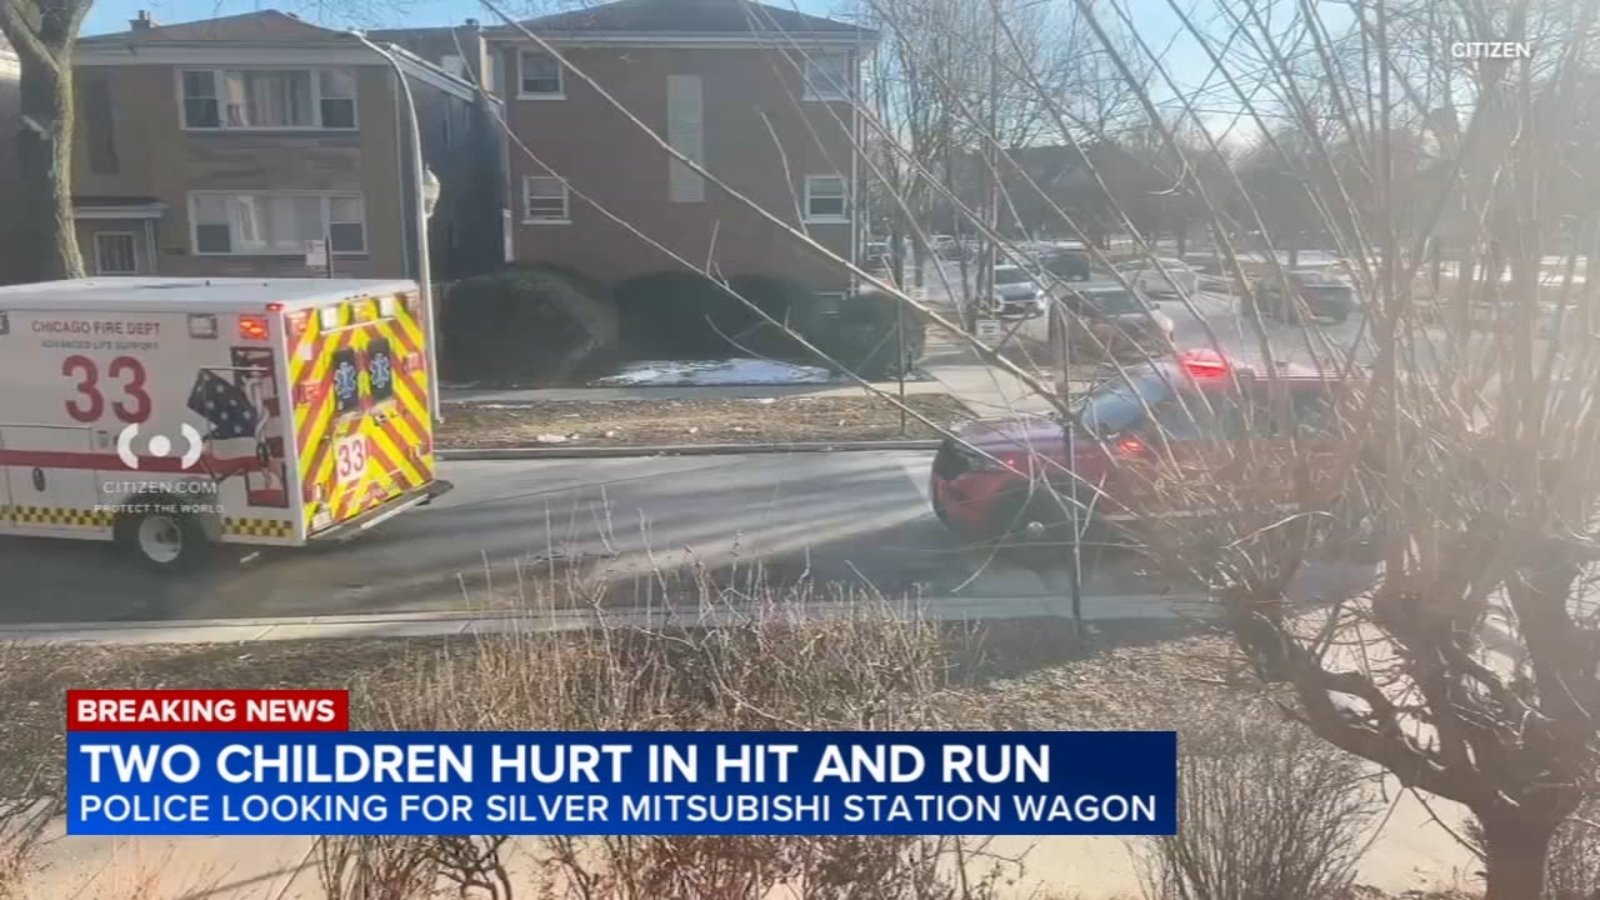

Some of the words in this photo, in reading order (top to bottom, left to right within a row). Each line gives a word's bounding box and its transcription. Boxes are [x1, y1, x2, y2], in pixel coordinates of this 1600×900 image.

[31, 320, 91, 334] CHICAGO
[93, 321, 124, 335] FIRE
[126, 322, 161, 336] DEPT
[62, 354, 152, 423] 33
[337, 438, 366, 478] 33
